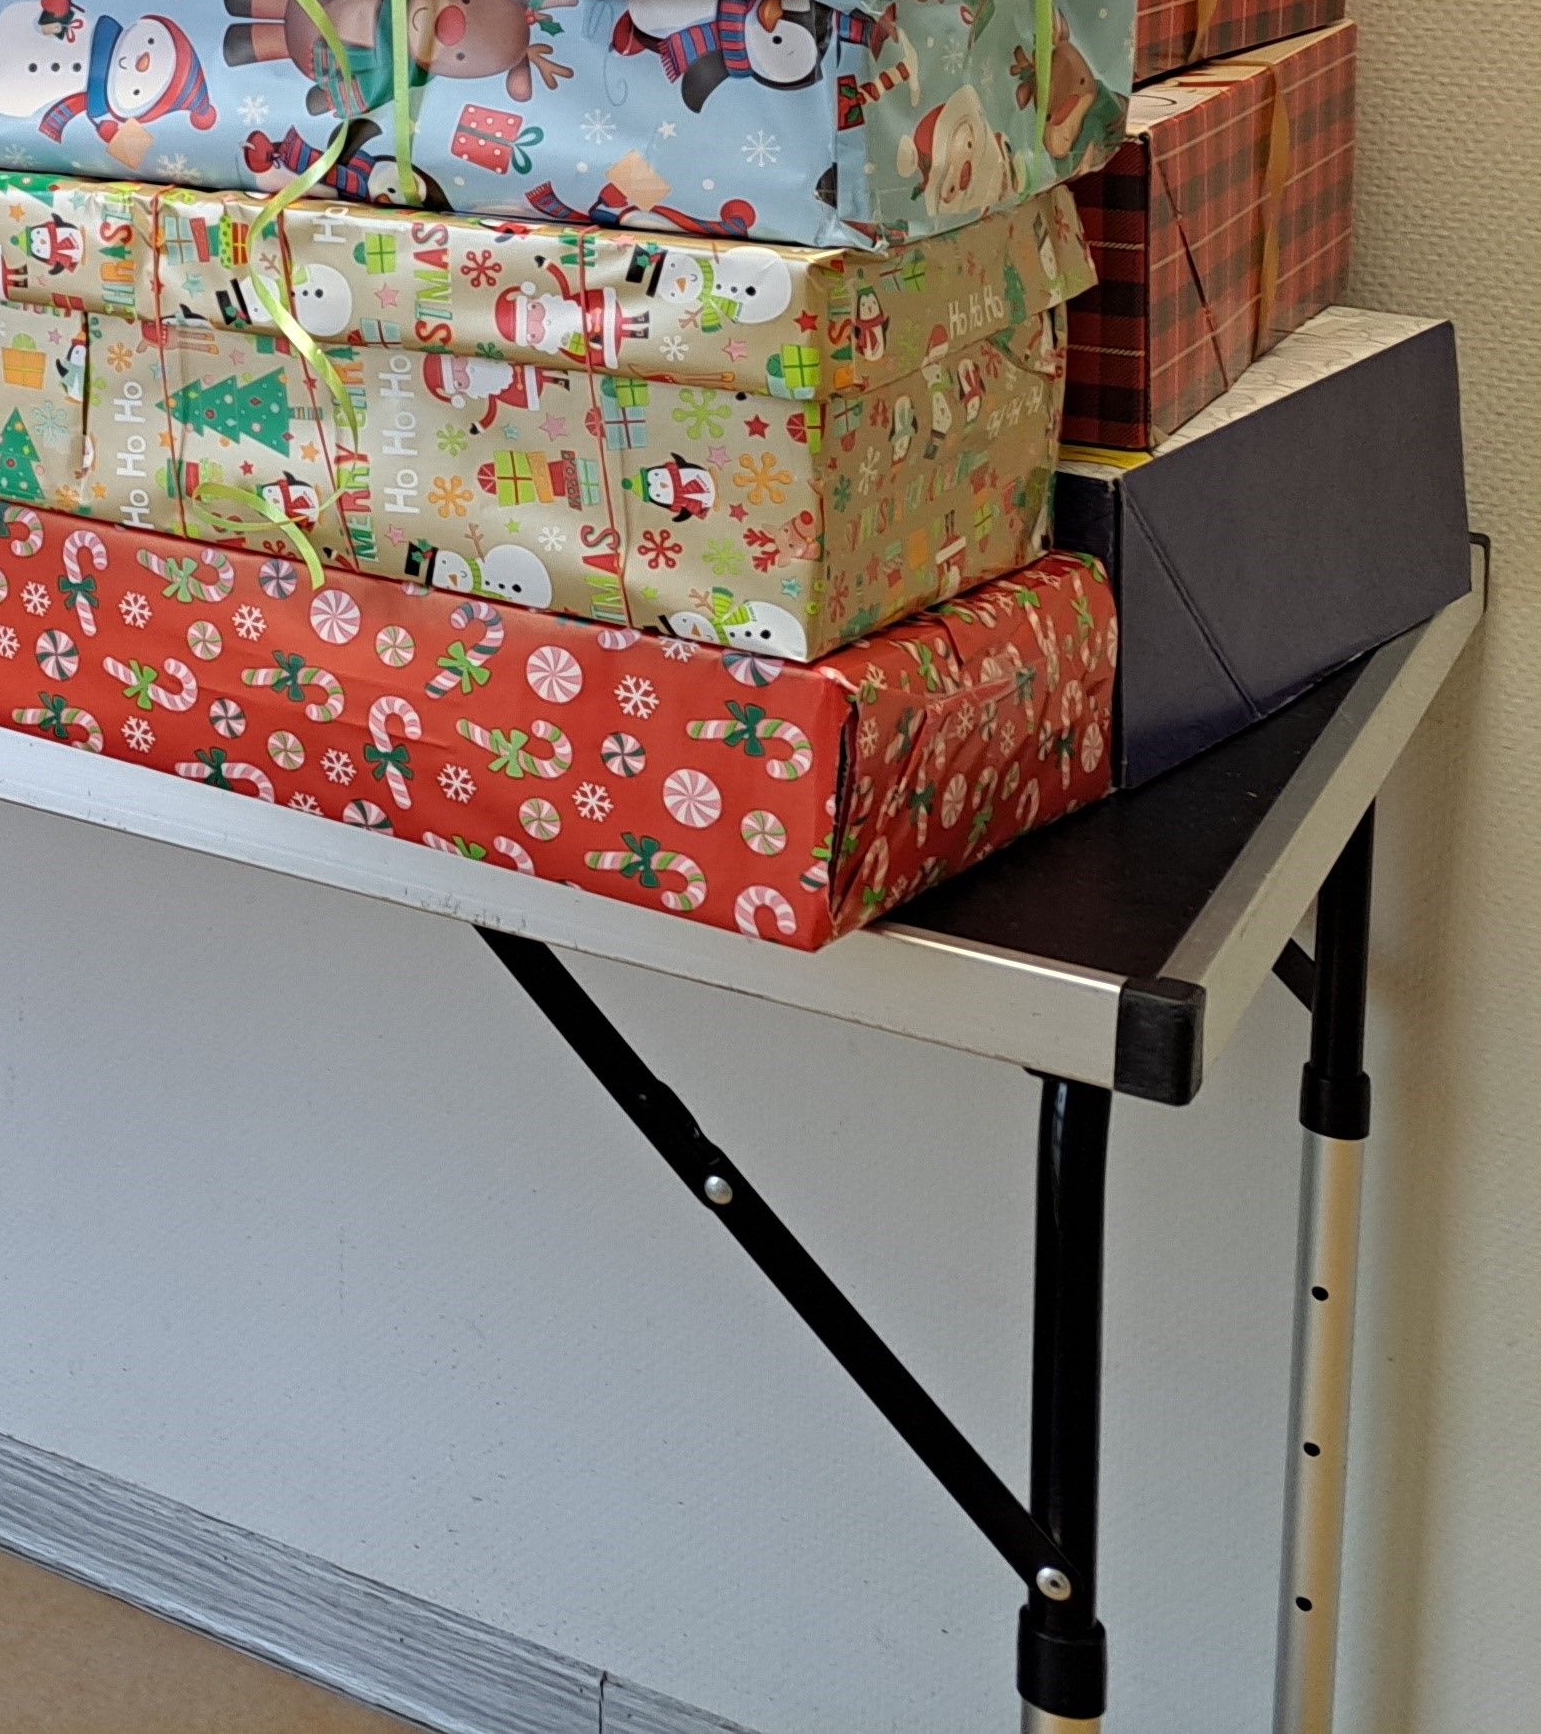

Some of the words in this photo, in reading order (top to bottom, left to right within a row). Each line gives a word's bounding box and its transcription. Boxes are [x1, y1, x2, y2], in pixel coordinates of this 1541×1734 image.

[948, 300, 968, 340] Ho
[379, 354, 413, 401] Ho
[113, 380, 144, 424] Ho
[381, 410, 417, 457] Ho
[116, 434, 147, 478] Ho
[120, 488, 151, 529] Ho
[385, 466, 420, 514] Ho
